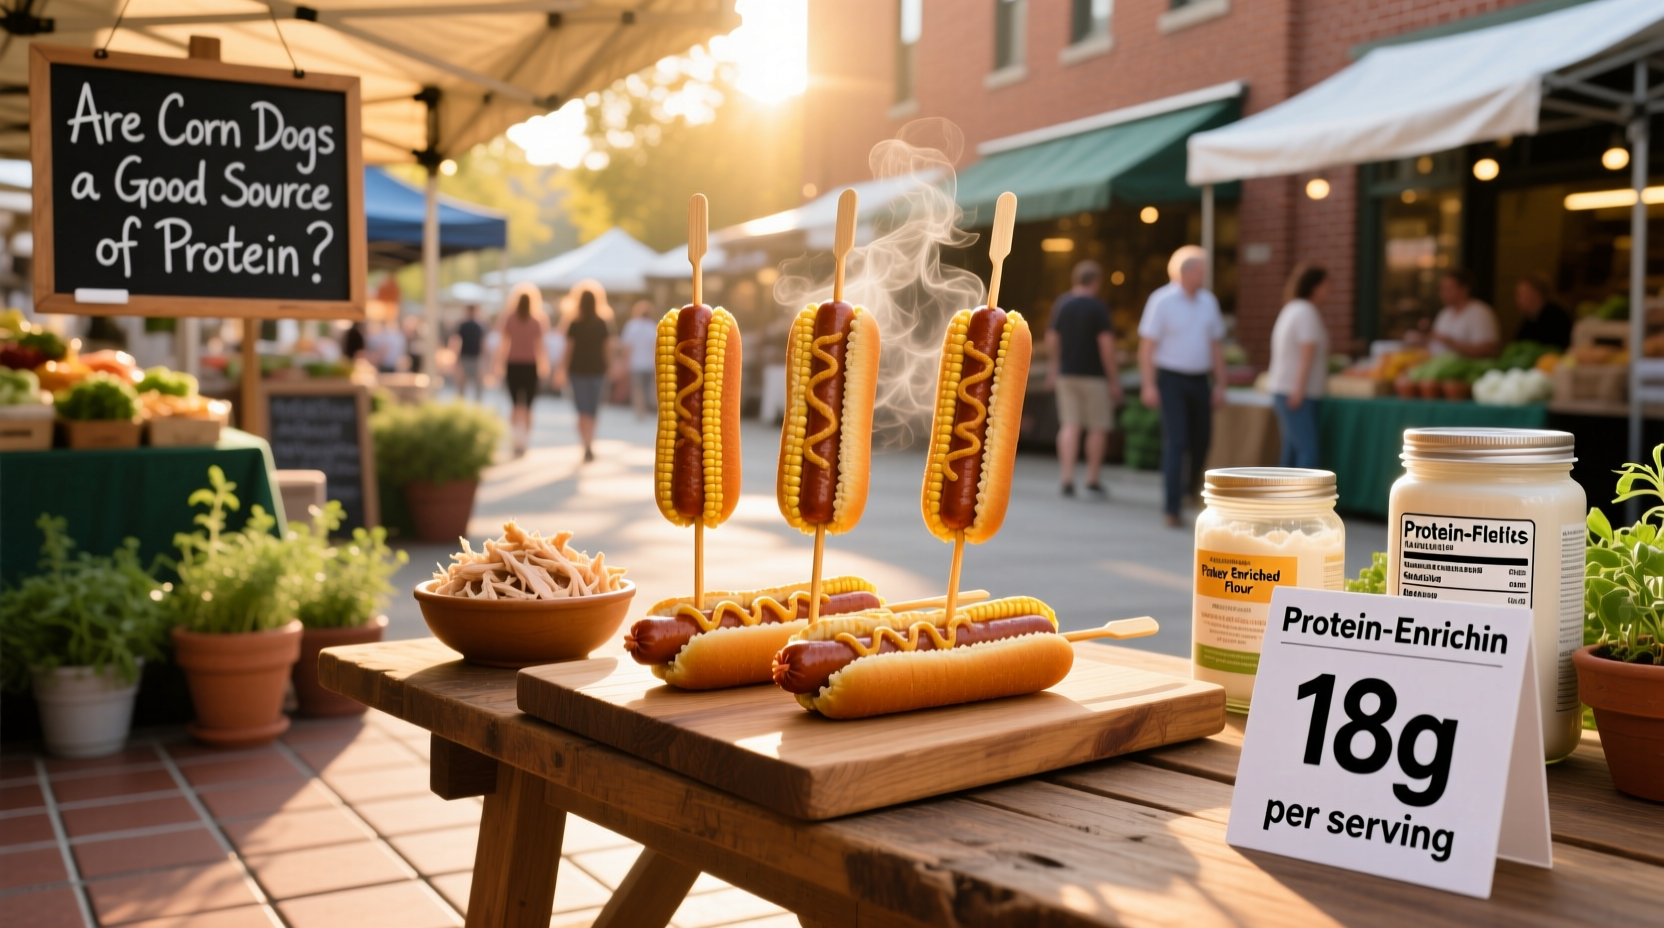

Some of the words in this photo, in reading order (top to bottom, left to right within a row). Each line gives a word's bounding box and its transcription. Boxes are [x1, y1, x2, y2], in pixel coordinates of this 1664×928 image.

[67, 82, 145, 145] Are
[158, 92, 241, 148] Corn
[250, 101, 335, 174] Dogs
[71, 171, 101, 200] a
[114, 155, 207, 209] Good
[220, 162, 332, 211] Source
[96, 216, 142, 278] of
[1225, 581, 1254, 594] Flour
[1231, 567, 1280, 582] Enriched
[1281, 606, 1508, 654] Protein-Enrichin
[1297, 673, 1459, 807] 18g
[1263, 799, 1320, 830] per
[1326, 810, 1455, 862] serving
